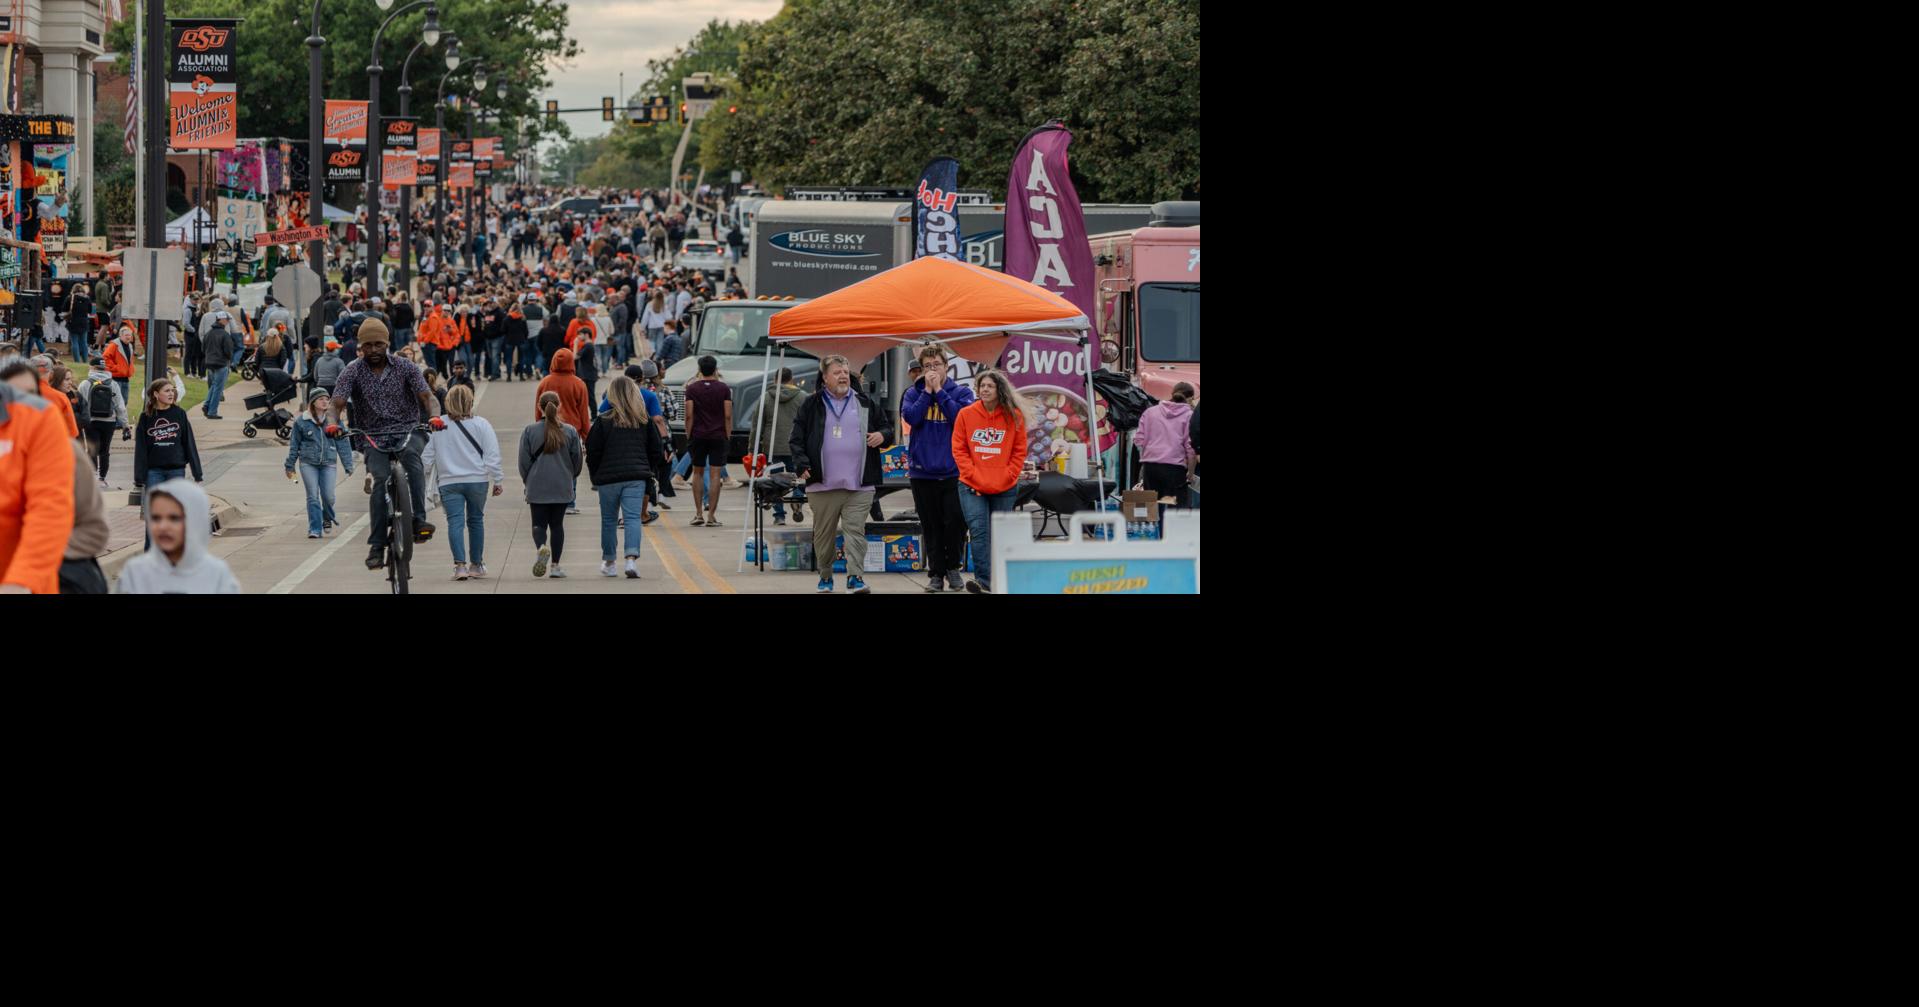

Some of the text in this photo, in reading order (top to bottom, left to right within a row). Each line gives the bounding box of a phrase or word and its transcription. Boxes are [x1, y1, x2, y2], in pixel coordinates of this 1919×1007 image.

[178, 25, 229, 52] OSU
[178, 54, 228, 66] ALUMNI
[170, 93, 233, 121] Welcome
[28, 120, 52, 136] THE
[189, 119, 232, 143] FRIENDS
[328, 150, 361, 168] OSU
[328, 168, 361, 176] ALUMNI
[270, 229, 312, 243] Washington
[315, 227, 323, 237] St
[788, 231, 865, 244] BLUE SKY
[789, 242, 863, 250] PRODUCTIONS
[771, 260, 878, 271] www.blueskytvmedia.com
